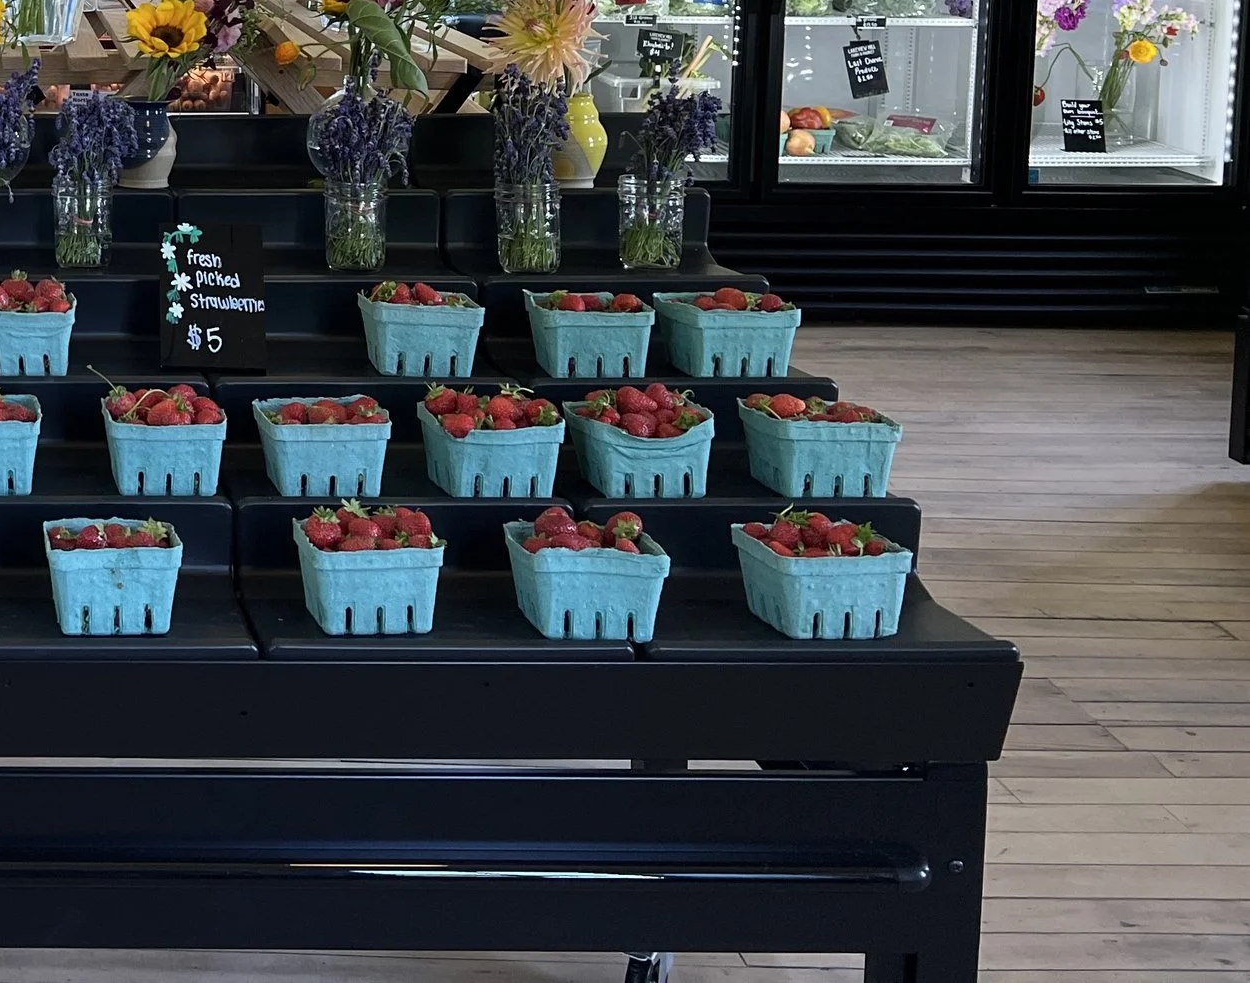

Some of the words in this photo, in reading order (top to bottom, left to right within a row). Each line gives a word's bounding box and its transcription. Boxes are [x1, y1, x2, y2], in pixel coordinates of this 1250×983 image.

[847, 58, 862, 68] Last
[186, 248, 223, 269] fresh
[186, 322, 223, 353] $5
